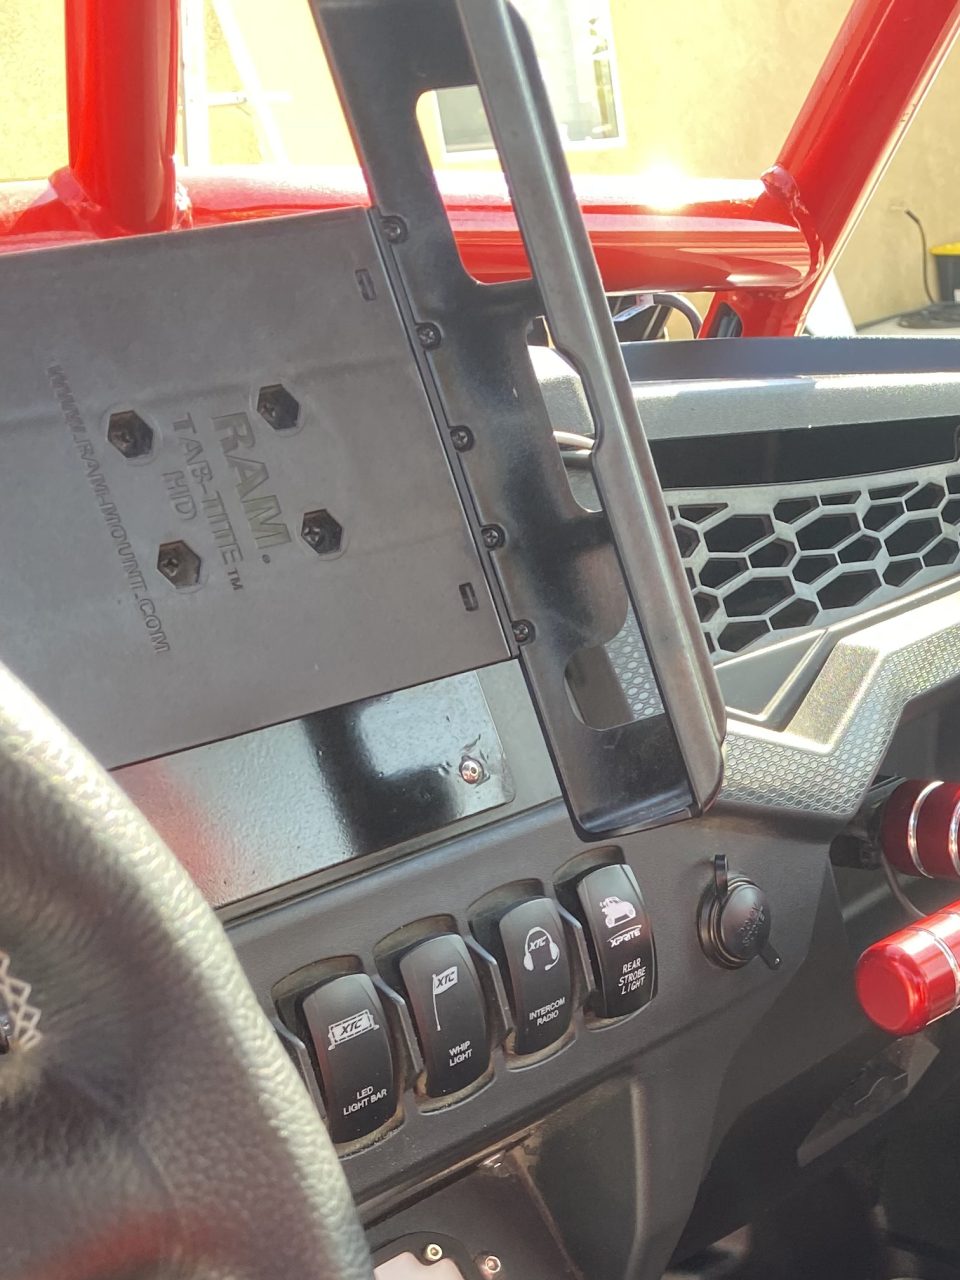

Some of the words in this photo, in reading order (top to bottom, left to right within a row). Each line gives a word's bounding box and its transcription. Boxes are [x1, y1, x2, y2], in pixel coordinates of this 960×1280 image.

[162, 470, 197, 521] HD
[528, 935, 548, 952] XTC
[608, 926, 642, 948] XPRITE
[622, 957, 642, 974] REAR
[436, 970, 456, 988] XTC
[618, 966, 647, 987] STROBE
[621, 977, 646, 995] LIGHT
[529, 996, 566, 1021] INTERCOM
[537, 1009, 559, 1026] RADIO
[340, 1018, 364, 1036] XTC
[449, 1040, 471, 1056] WHIP
[449, 1049, 472, 1067] LIGHT
[356, 1085, 374, 1100] LED
[343, 1098, 370, 1116] LIGHT
[370, 1088, 388, 1104] BAR
